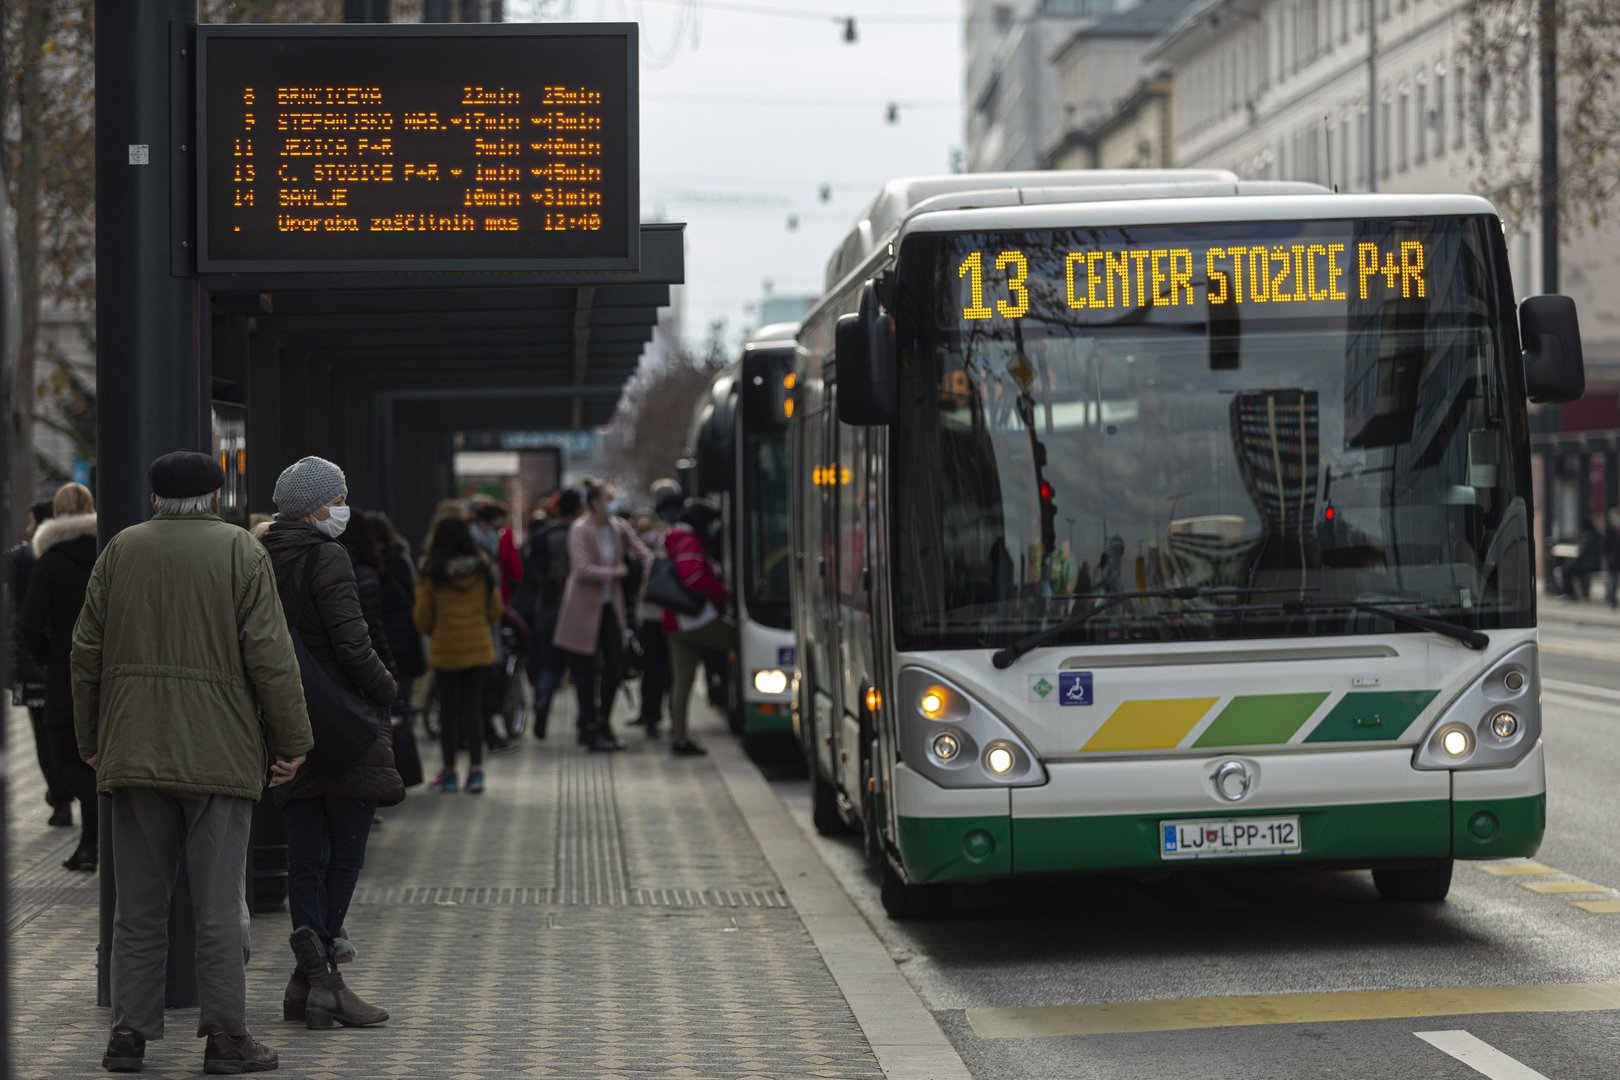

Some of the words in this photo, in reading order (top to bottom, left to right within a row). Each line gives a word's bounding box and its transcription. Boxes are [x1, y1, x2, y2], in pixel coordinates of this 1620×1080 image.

[461, 86, 520, 105] 22min
[462, 111, 520, 131] 17min
[233, 137, 254, 157] 11
[233, 162, 256, 182] 13
[233, 187, 254, 207] 14
[279, 187, 348, 207] SAVLJE
[277, 212, 360, 232] Uporaba
[958, 250, 1029, 320] 13
[1065, 247, 1196, 310] CENTER
[1358, 240, 1426, 300] P+R
[1180, 827, 1204, 848] LJ
[1221, 823, 1294, 846] LPP-112
